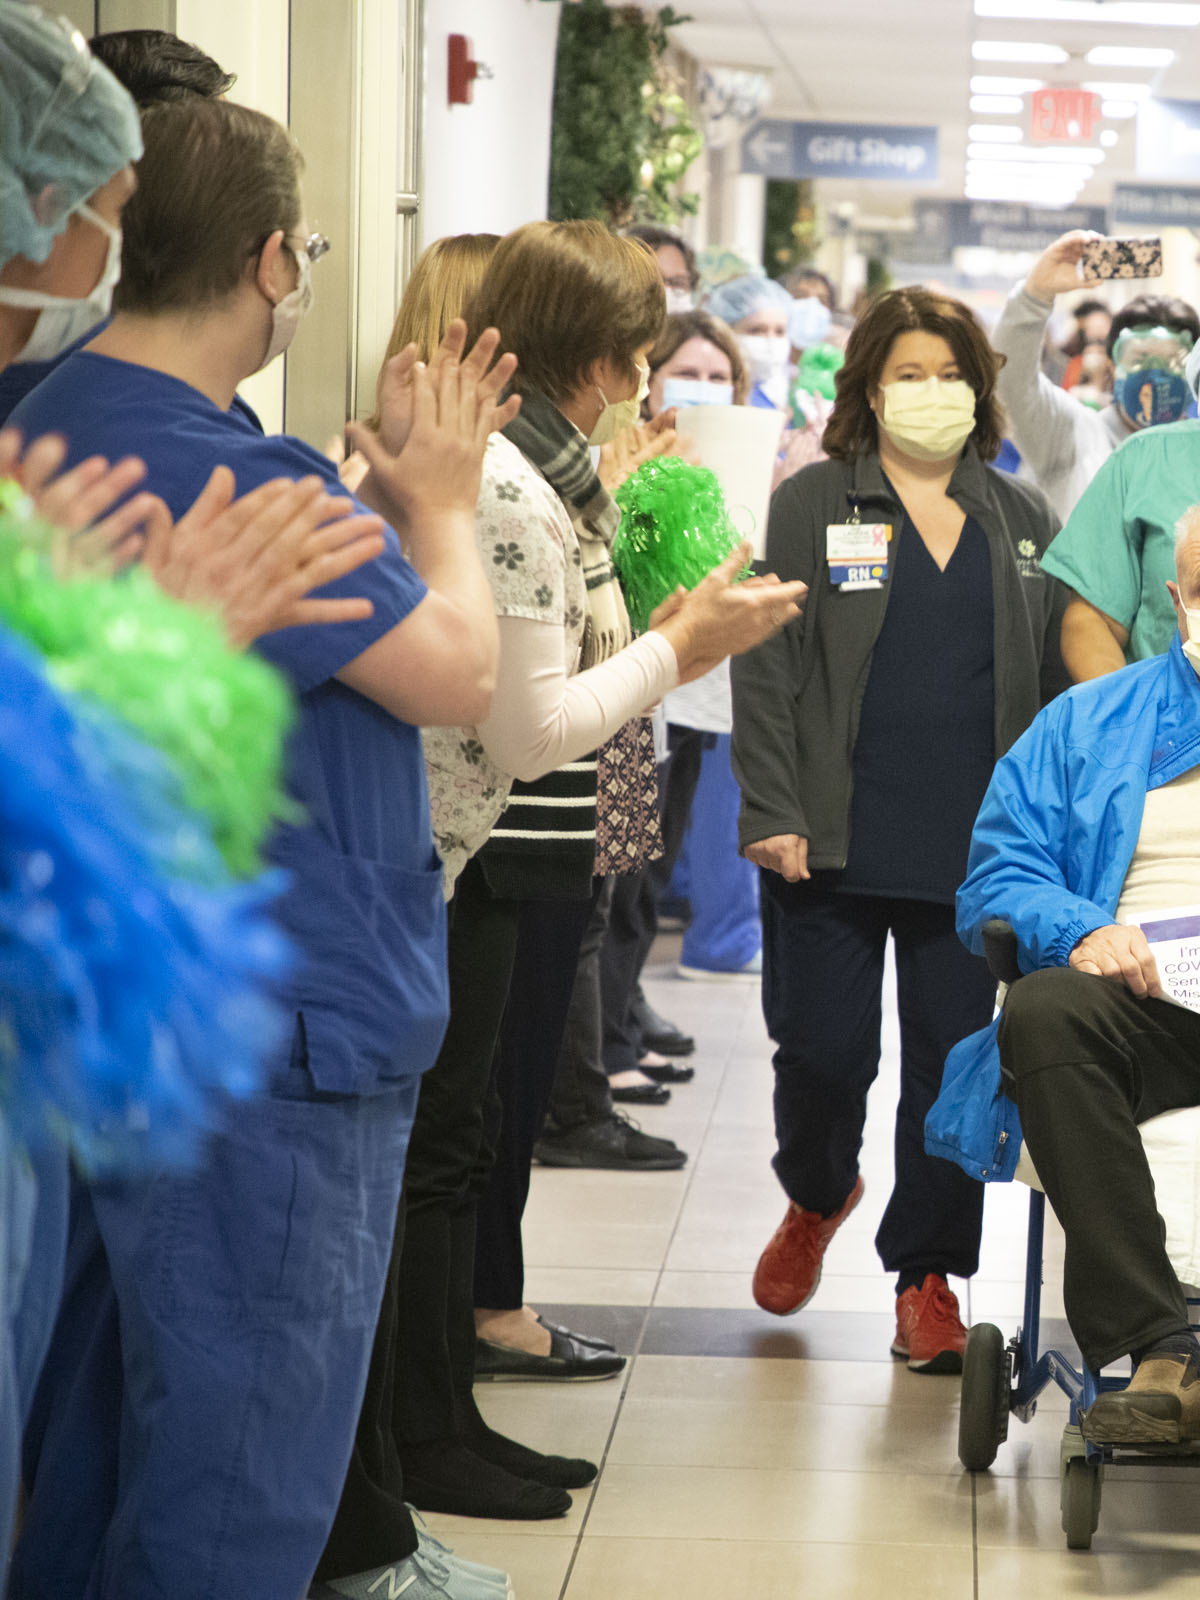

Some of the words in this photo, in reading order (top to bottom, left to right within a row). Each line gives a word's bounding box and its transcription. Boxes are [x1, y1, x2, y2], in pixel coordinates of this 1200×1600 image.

[807, 135, 856, 164] Gift
[859, 136, 928, 173] Shop
[848, 566, 870, 582] RN
